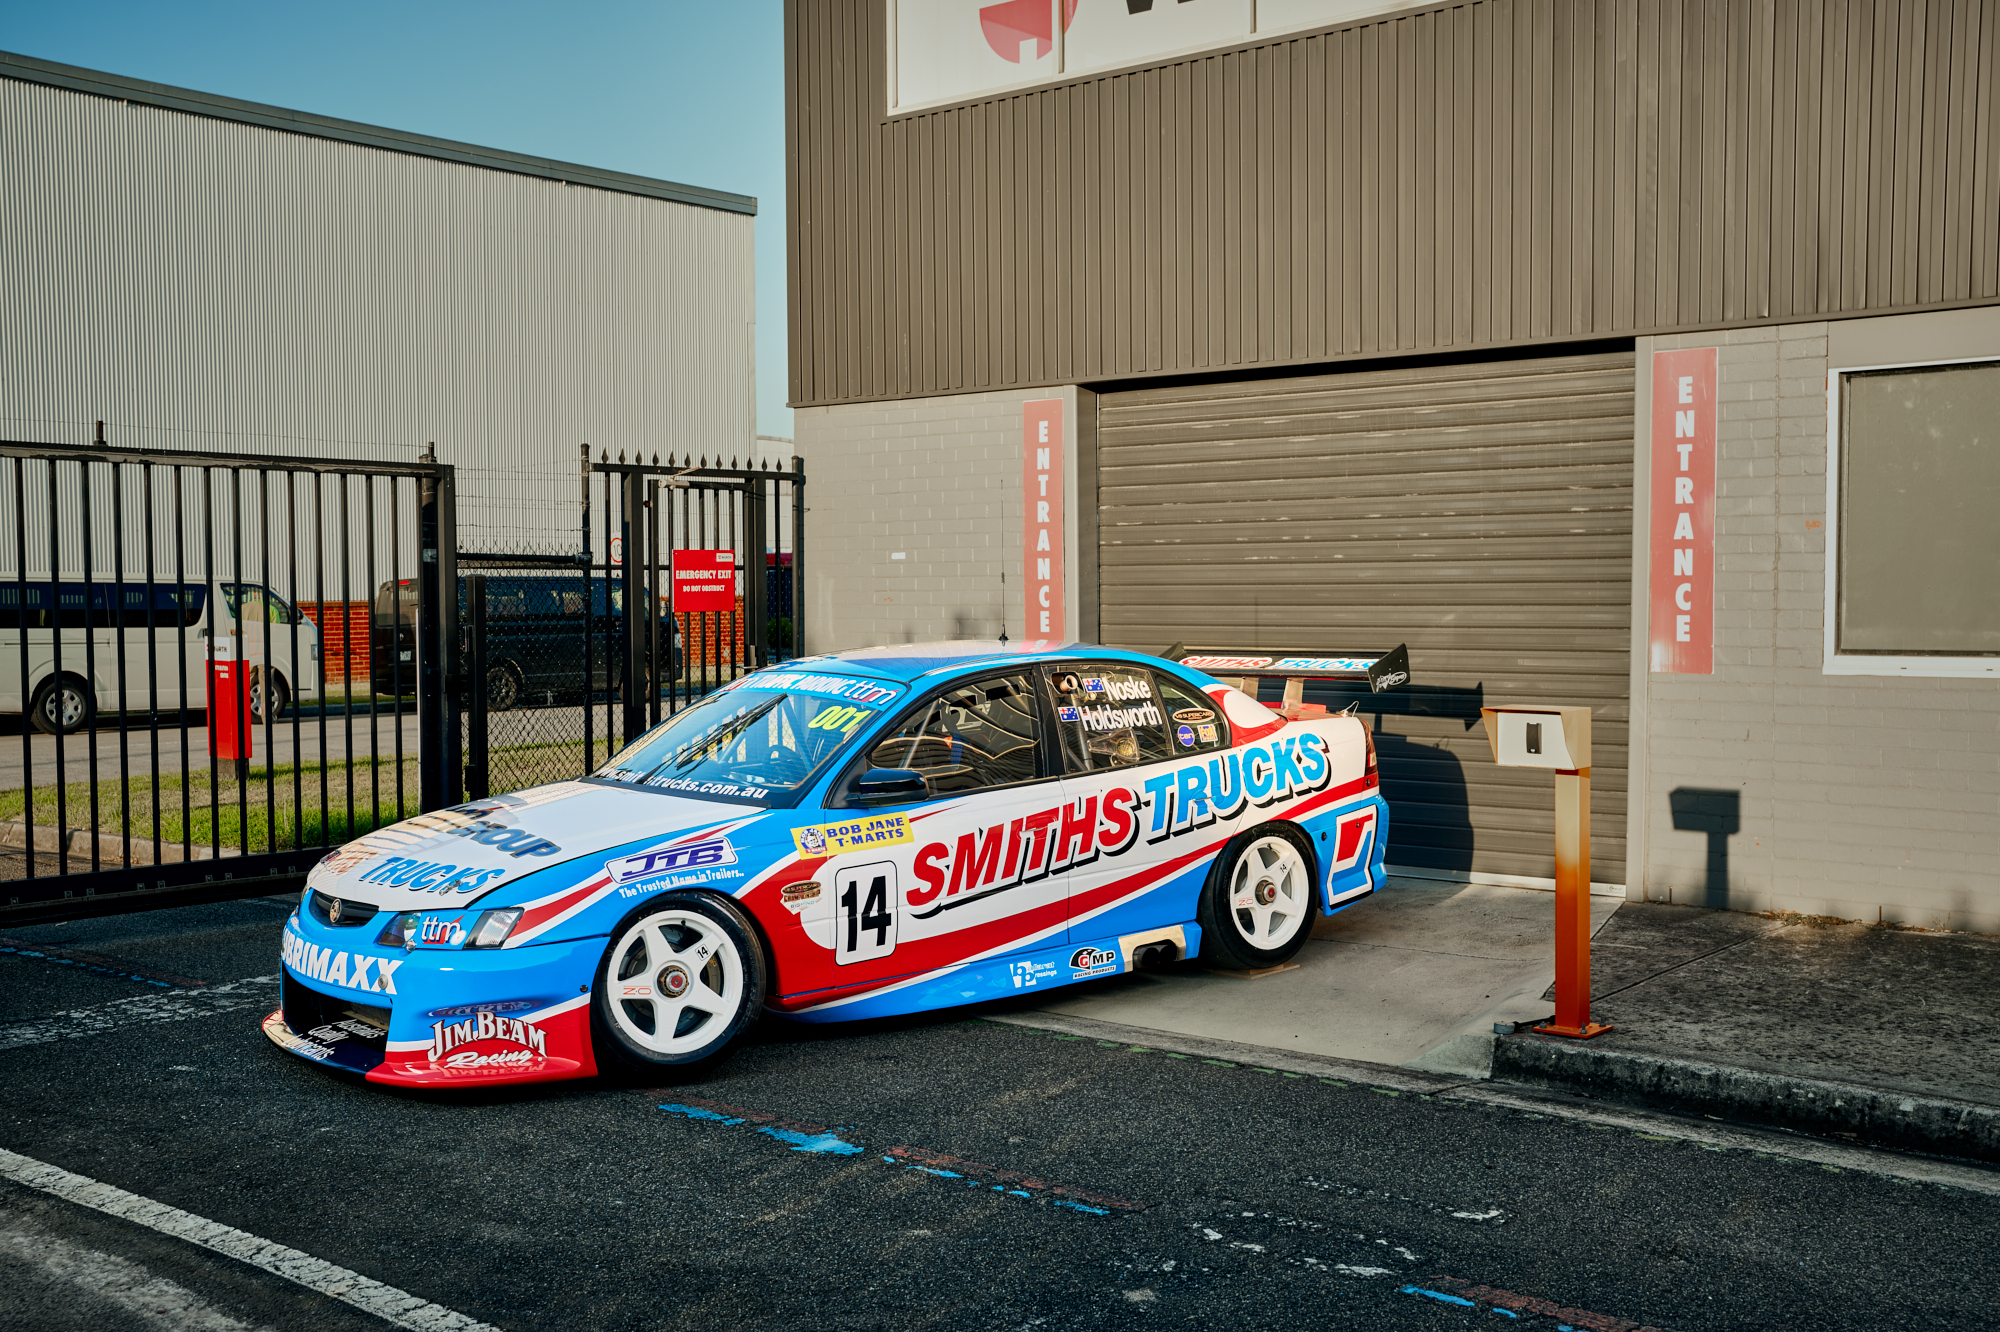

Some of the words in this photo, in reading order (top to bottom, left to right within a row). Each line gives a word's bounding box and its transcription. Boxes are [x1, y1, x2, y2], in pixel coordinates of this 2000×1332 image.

[1673, 375, 1695, 642] ENTRANCE
[1036, 420, 1051, 633] ENTRANCE
[676, 570, 716, 580] EMERGENCY
[718, 570, 732, 579] EXIT
[702, 584, 725, 592] OBSTRUCT
[1180, 656, 1270, 668] SMITHS
[1274, 658, 1379, 670] TRUCKS
[844, 680, 902, 706] ttm
[1102, 676, 1151, 701] Noske
[807, 706, 871, 732] 001
[1078, 701, 1163, 731] Holdsworth
[826, 824, 861, 838] BOB
[866, 817, 905, 831] JANE
[906, 787, 1136, 908] SMITHS
[1144, 733, 1328, 832] TRUCKS
[446, 820, 561, 859] GROUP
[835, 828, 904, 847] T-MARTS
[620, 840, 724, 880] JTB
[1279, 863, 1287, 873] 14
[359, 856, 506, 894] TRUCKS
[619, 888, 637, 899] The
[637, 878, 671, 894] Trusted
[671, 875, 697, 887] Name
[697, 871, 706, 882] in
[841, 875, 892, 953] 14
[421, 915, 462, 943] ttm
[697, 946, 709, 959] 14
[1080, 951, 1115, 967] GMP
[1074, 970, 1091, 978] RACING
[1092, 966, 1115, 975] PRODUCTS
[427, 1018, 474, 1062] JIM
[475, 1011, 549, 1060] BEAM
[444, 1049, 533, 1068] Racing
